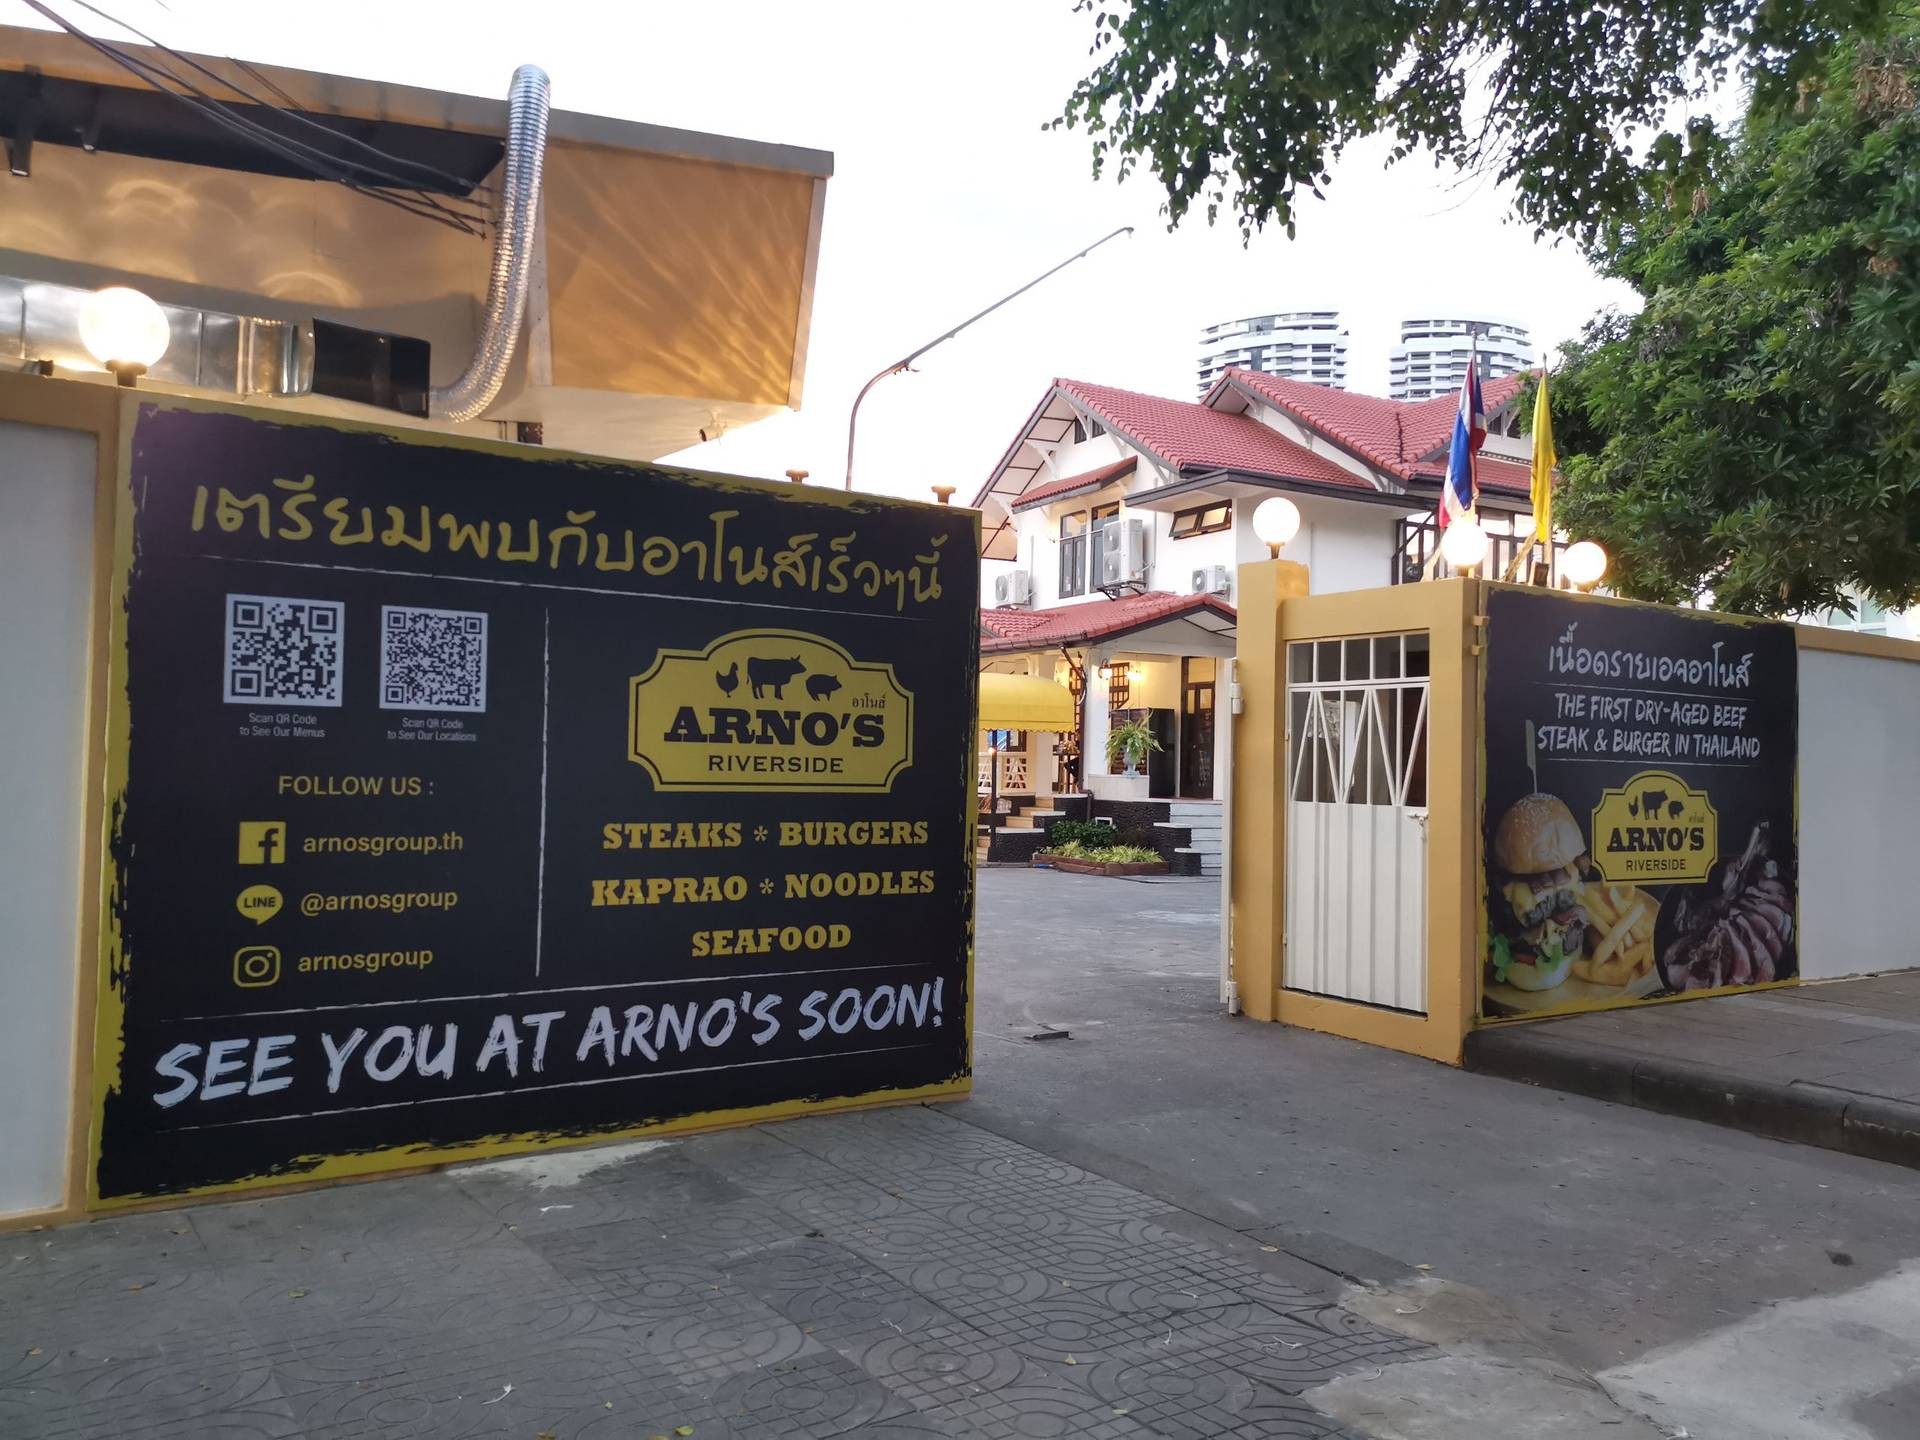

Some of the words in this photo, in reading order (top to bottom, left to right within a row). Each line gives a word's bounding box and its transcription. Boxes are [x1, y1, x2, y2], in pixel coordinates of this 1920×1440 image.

[249, 712, 274, 724] Scan
[276, 713, 290, 725] QR
[292, 714, 317, 725] Code
[402, 717, 425, 728] Scan
[427, 718, 439, 729] QR
[441, 718, 463, 729] Code
[1555, 692, 1586, 719] THE
[1590, 695, 1633, 723] FIRST
[1635, 699, 1709, 727] DRY-AGED
[1712, 704, 1748, 729] BEEF
[240, 726, 250, 736] to
[252, 726, 271, 737] See
[273, 727, 290, 737] Our
[292, 727, 326, 738] Menus
[387, 730, 396, 740] to
[398, 730, 415, 740] See
[417, 730, 433, 741] Our
[435, 731, 477, 742] Locations
[663, 706, 886, 748] ARNO'S
[1537, 725, 1590, 753] STEAK
[1593, 728, 1608, 752] &
[1612, 729, 1671, 757] BURGER
[1675, 733, 1690, 756] IN
[1692, 734, 1761, 759] THAILAND
[707, 755, 844, 773] RIVERSIDE
[278, 775, 383, 795] FOLLOW
[303, 831, 464, 856] arnosgroup.th
[602, 822, 743, 849] STEAKS
[779, 821, 929, 846] BURGERS
[1606, 827, 1705, 852] ARNO'S
[1626, 858, 1687, 872] RIVERSIDE
[591, 875, 748, 906] KAPRAO
[784, 870, 935, 898] NOODLES
[243, 897, 276, 909] LINE
[301, 891, 458, 917] @arnosgroup
[691, 924, 851, 957] SEAFOOD
[298, 950, 433, 973] arnosgroup
[152, 1034, 297, 1109] SEE
[320, 1022, 459, 1093] YOU
[476, 1011, 566, 1079] AT
[576, 991, 782, 1067] ARNO'S
[798, 976, 944, 1041] SOON!
